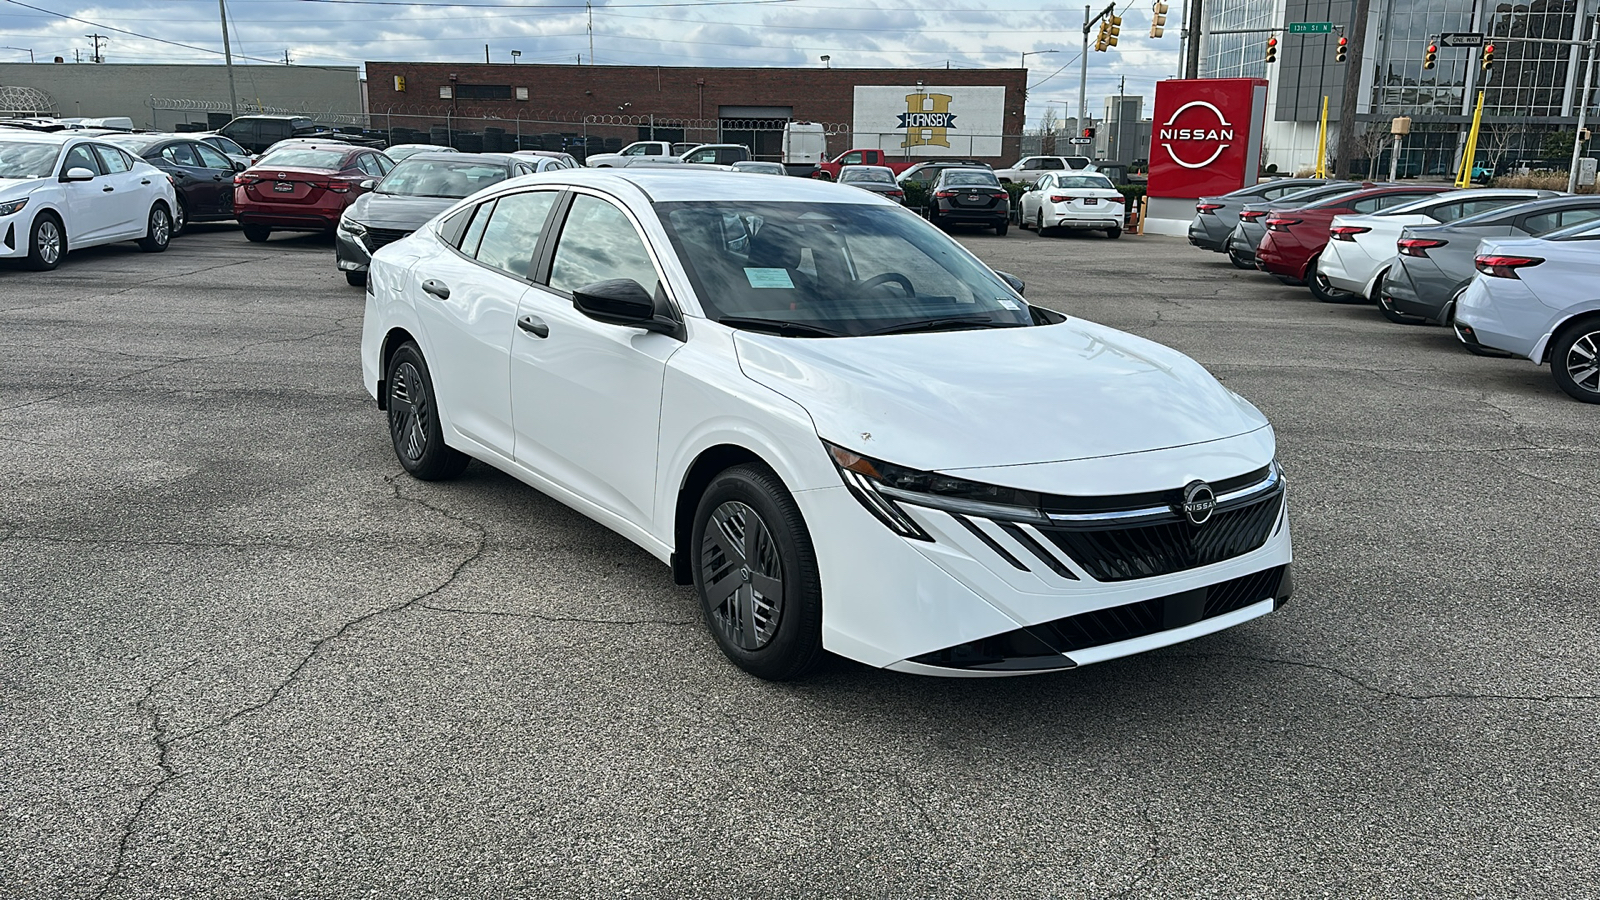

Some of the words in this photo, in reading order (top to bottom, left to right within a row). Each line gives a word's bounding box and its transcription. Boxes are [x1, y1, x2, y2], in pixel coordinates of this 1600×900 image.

[905, 113, 950, 127] HORNSBY
[1160, 129, 1233, 140] NISSAN
[1184, 501, 1217, 512] NISSAN
